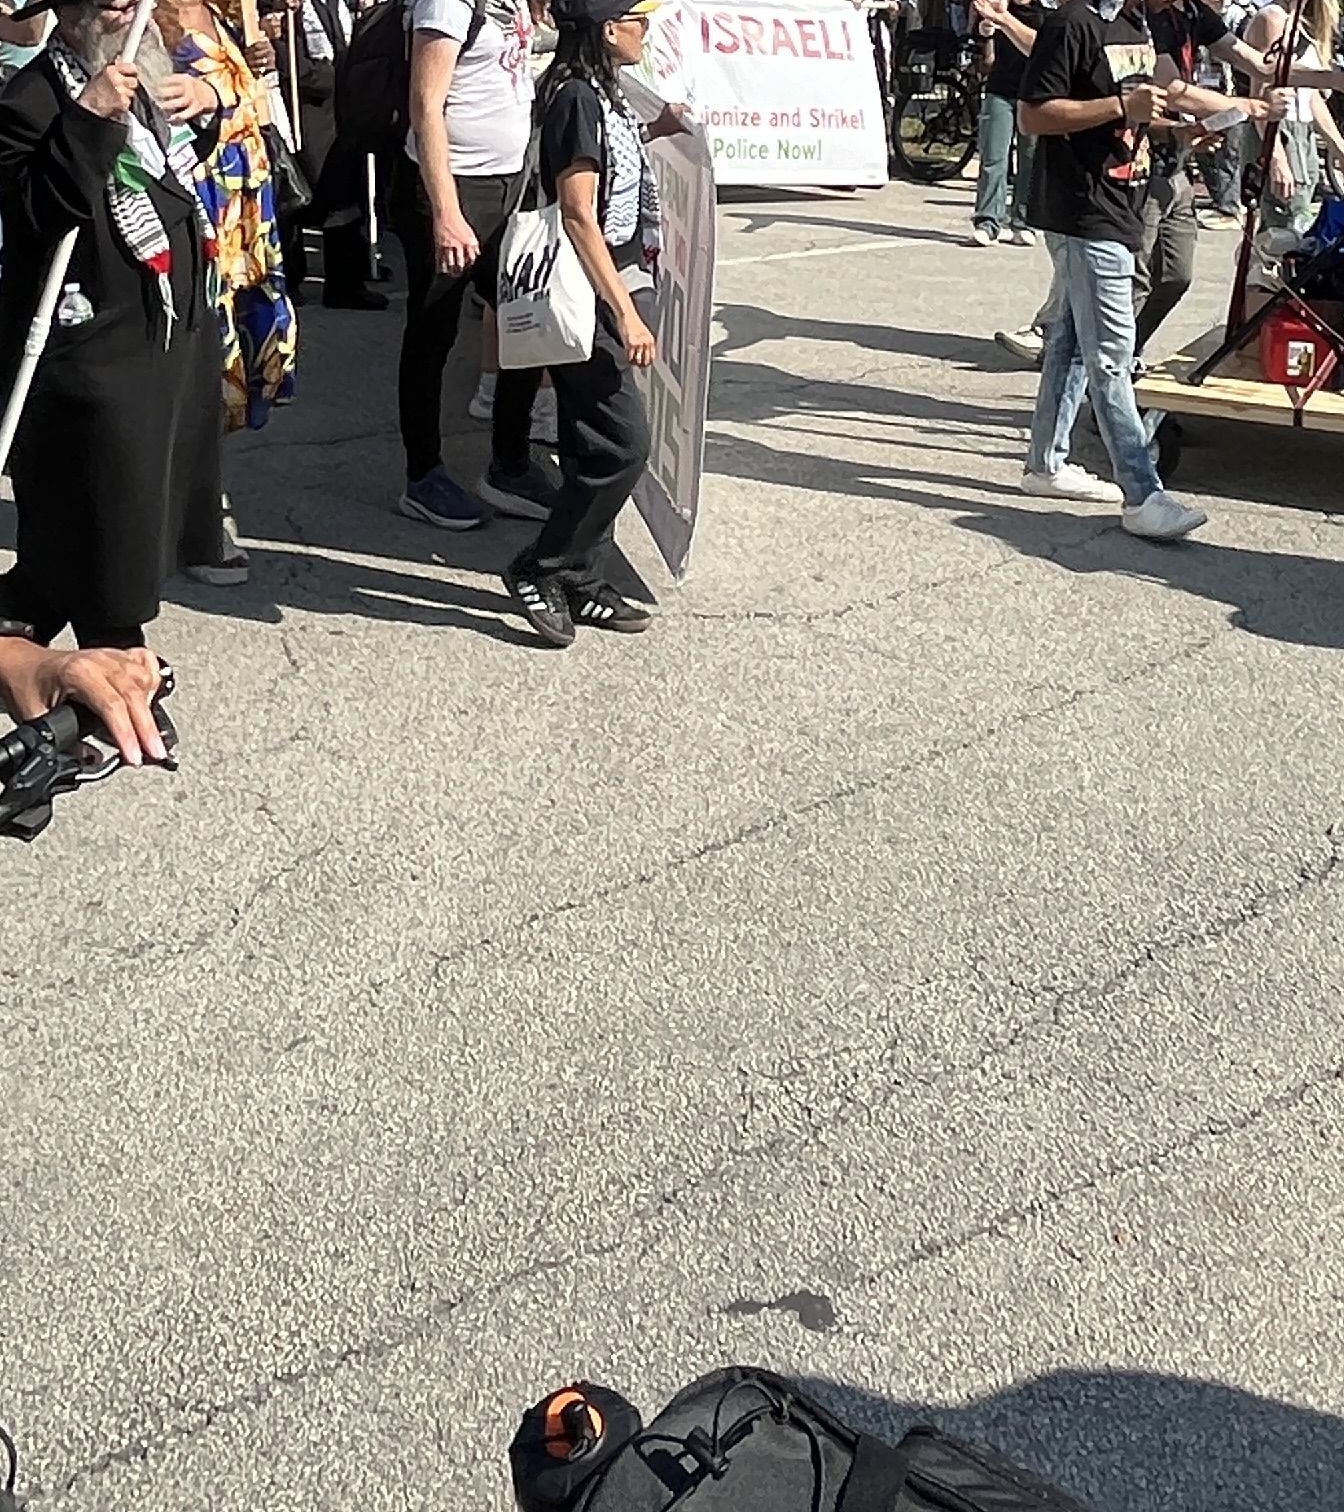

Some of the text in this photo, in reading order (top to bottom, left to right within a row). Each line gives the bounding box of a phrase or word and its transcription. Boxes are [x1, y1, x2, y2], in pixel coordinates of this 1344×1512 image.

[700, 11, 855, 61] ISRAEL!
[702, 105, 866, 131] ionize and Strike!
[712, 138, 823, 161] Police Now!
